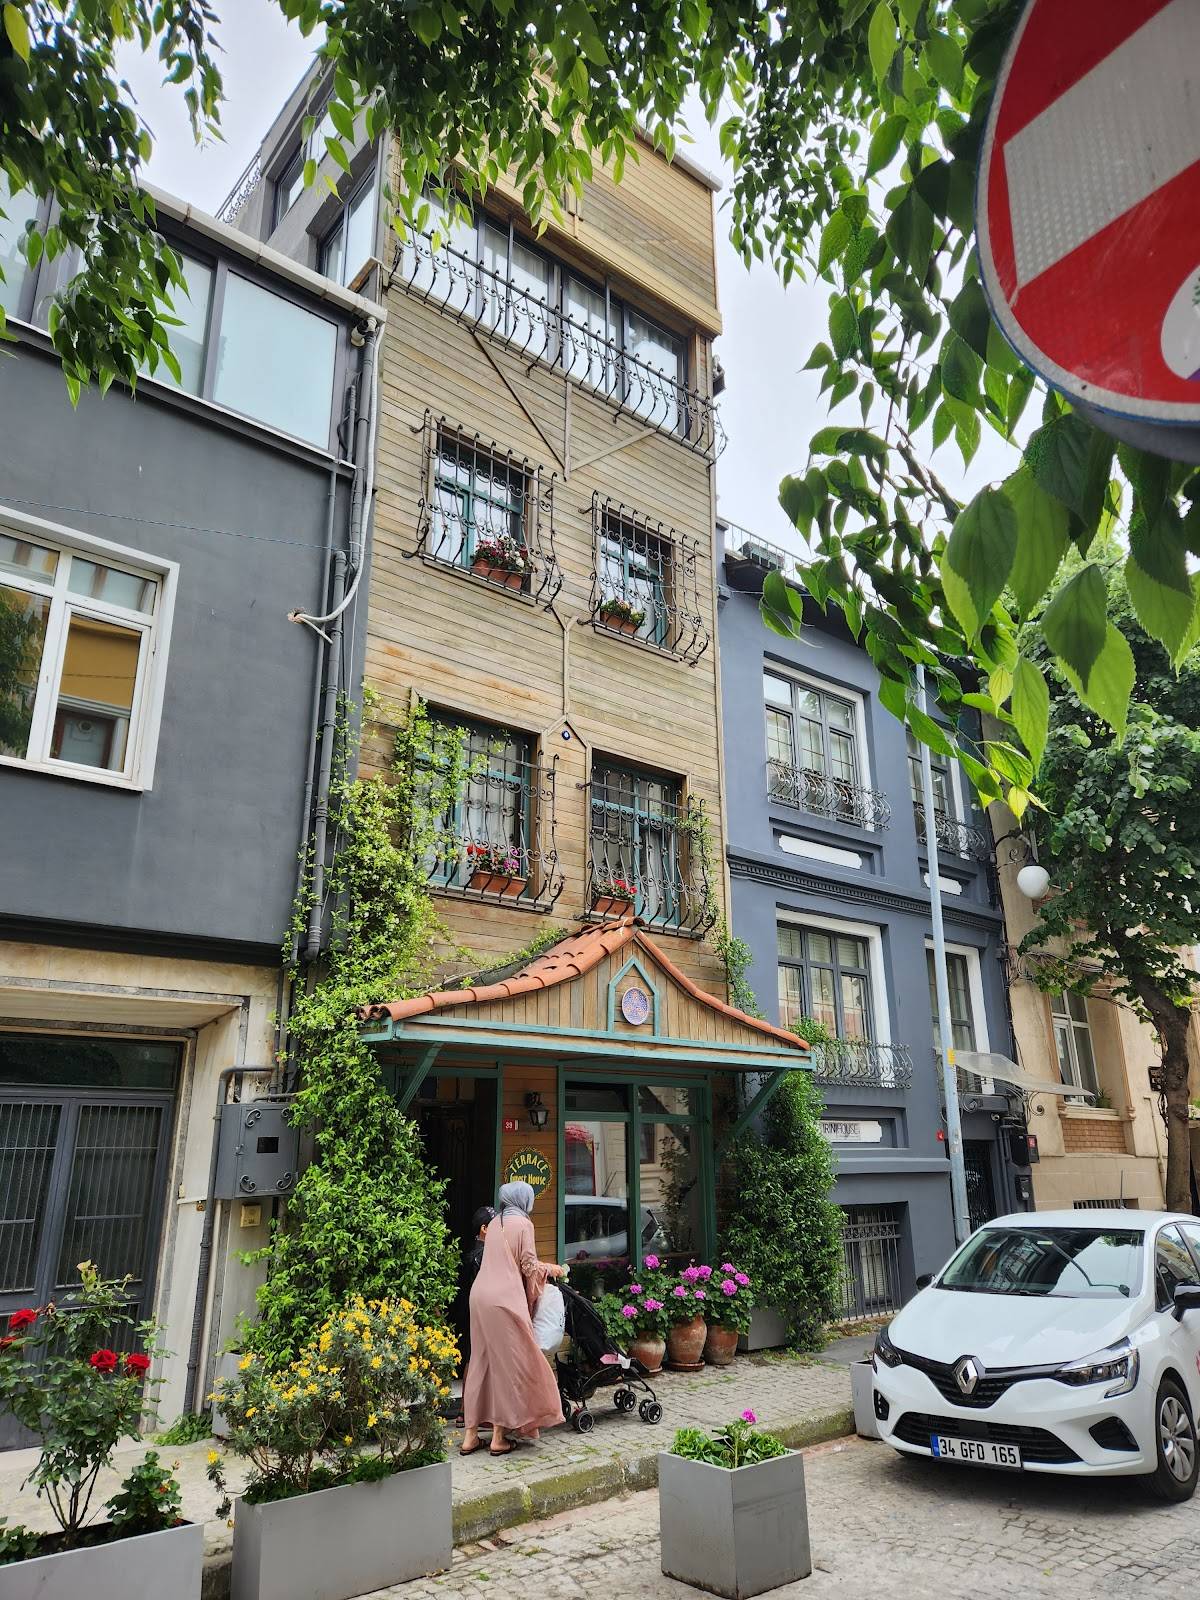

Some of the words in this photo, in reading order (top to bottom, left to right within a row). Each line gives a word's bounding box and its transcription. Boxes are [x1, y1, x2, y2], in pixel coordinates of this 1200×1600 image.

[509, 1153, 549, 1173] TERRACE
[940, 1439, 956, 1456] 34
[960, 1441, 985, 1460] GFD
[991, 1445, 1017, 1464] 165
